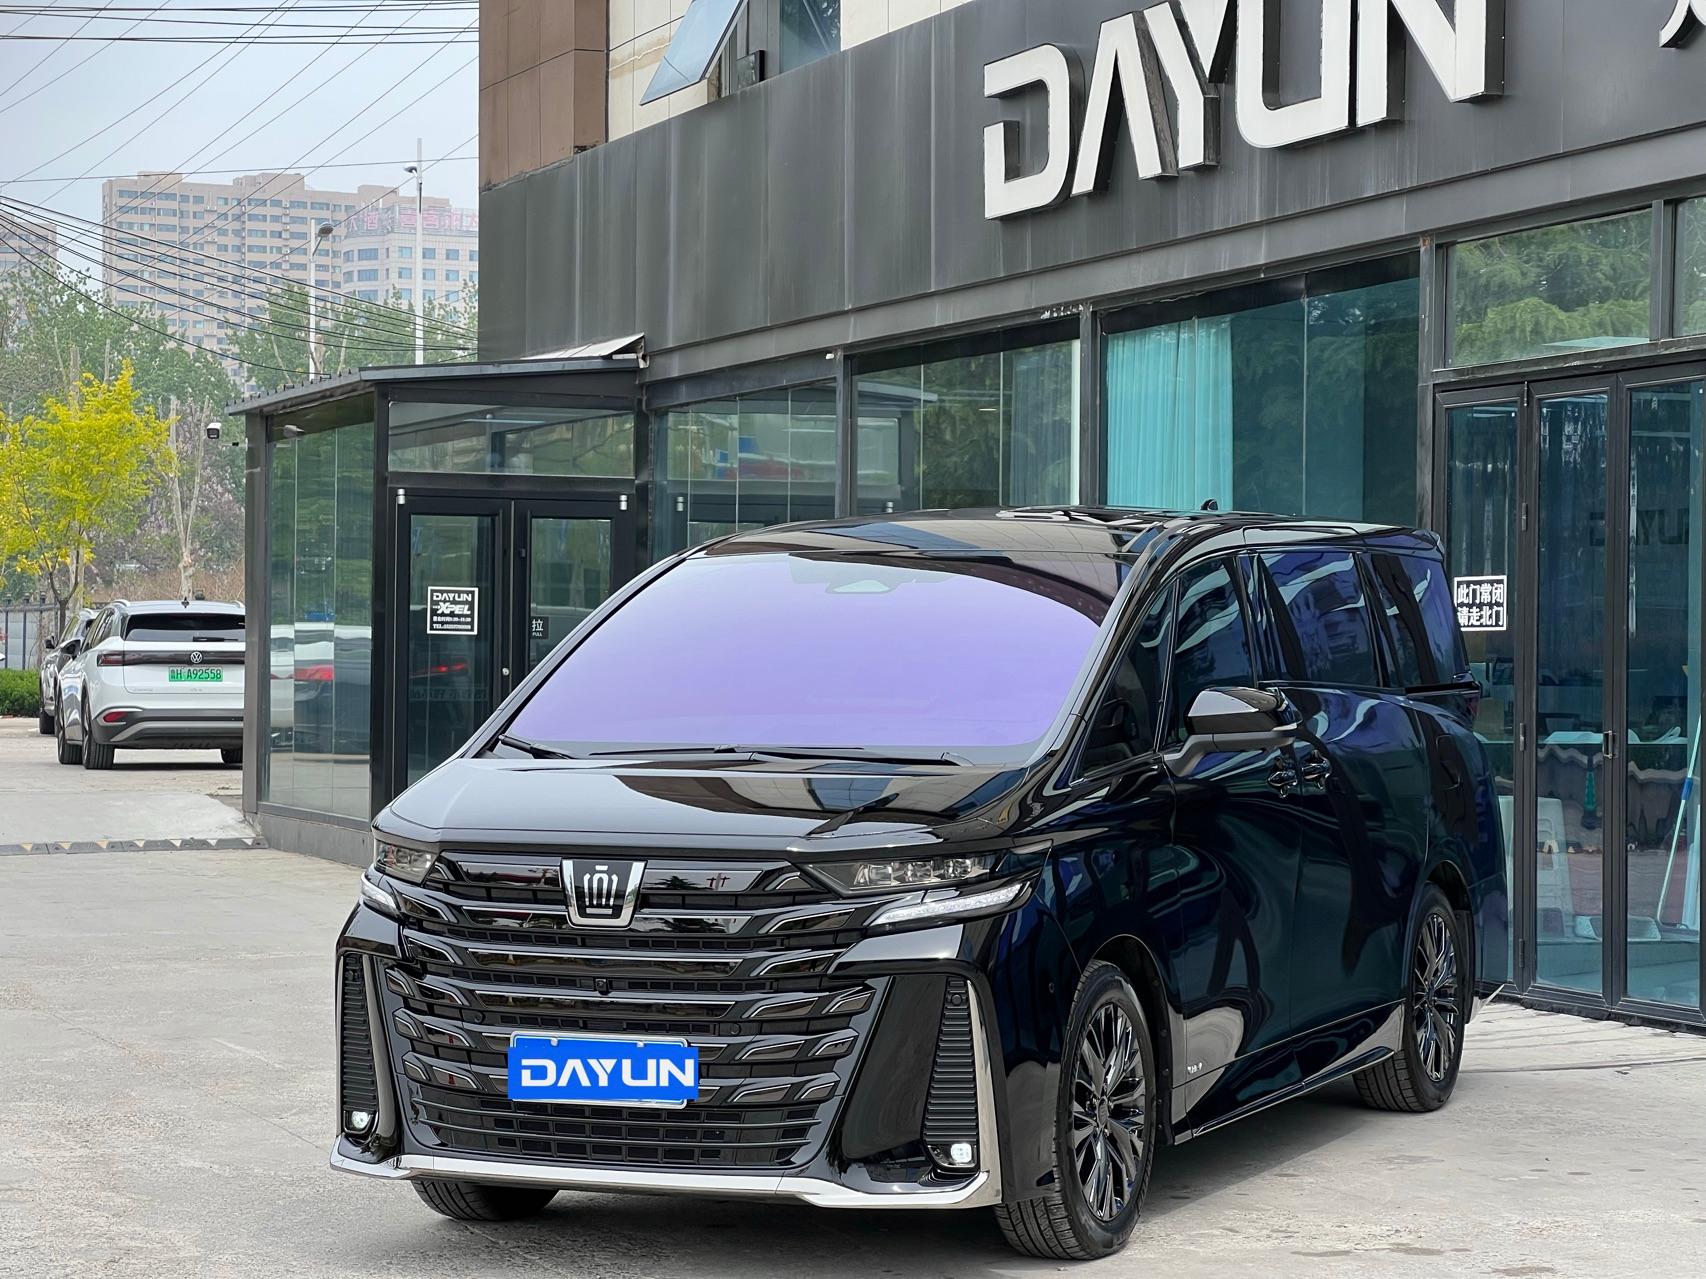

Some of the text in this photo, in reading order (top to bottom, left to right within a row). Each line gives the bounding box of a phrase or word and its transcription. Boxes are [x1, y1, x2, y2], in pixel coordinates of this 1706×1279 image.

[433, 593, 472, 601] DAYUN
[1457, 583, 1504, 604] 此门常闭
[436, 602, 471, 614] XPEL
[1457, 605, 1503, 626] 请走北门
[532, 619, 543, 631] 拉
